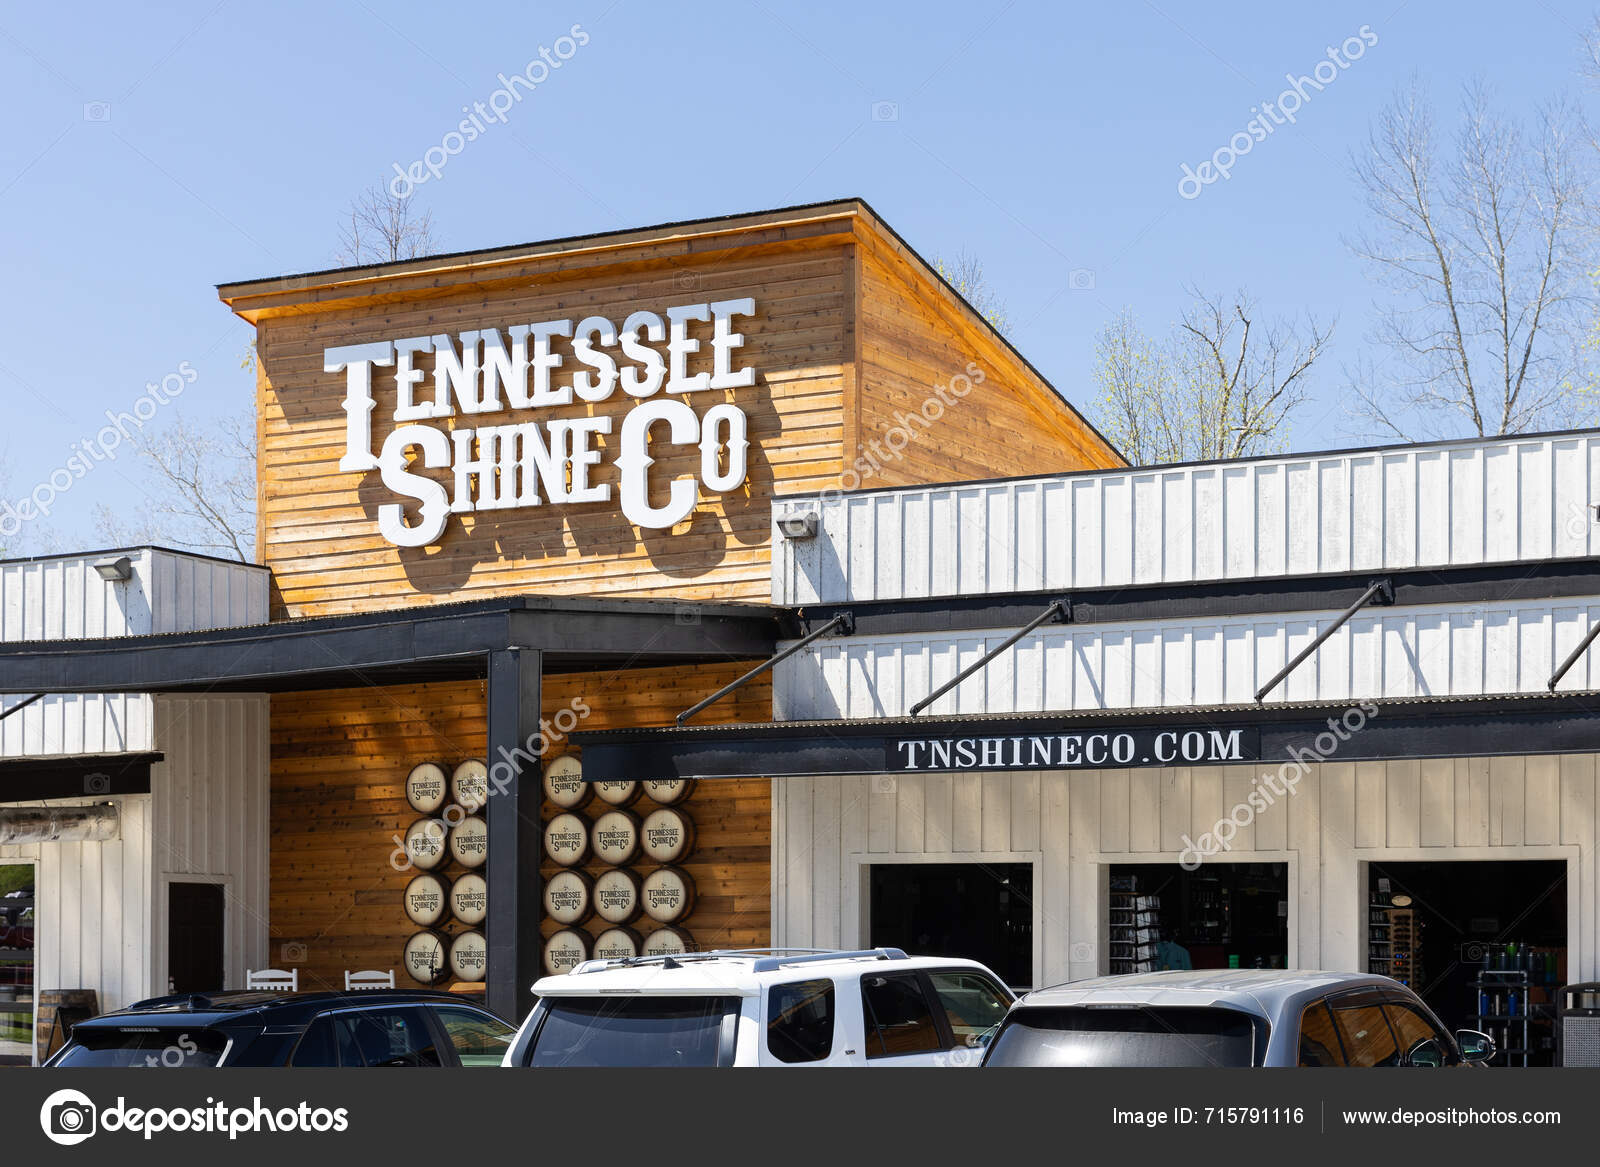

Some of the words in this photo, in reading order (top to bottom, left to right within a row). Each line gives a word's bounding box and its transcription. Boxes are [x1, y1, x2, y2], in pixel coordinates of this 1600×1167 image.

[324, 297, 756, 472] TENNESSEE
[378, 424, 613, 547] SHINE
[614, 399, 750, 529] CO
